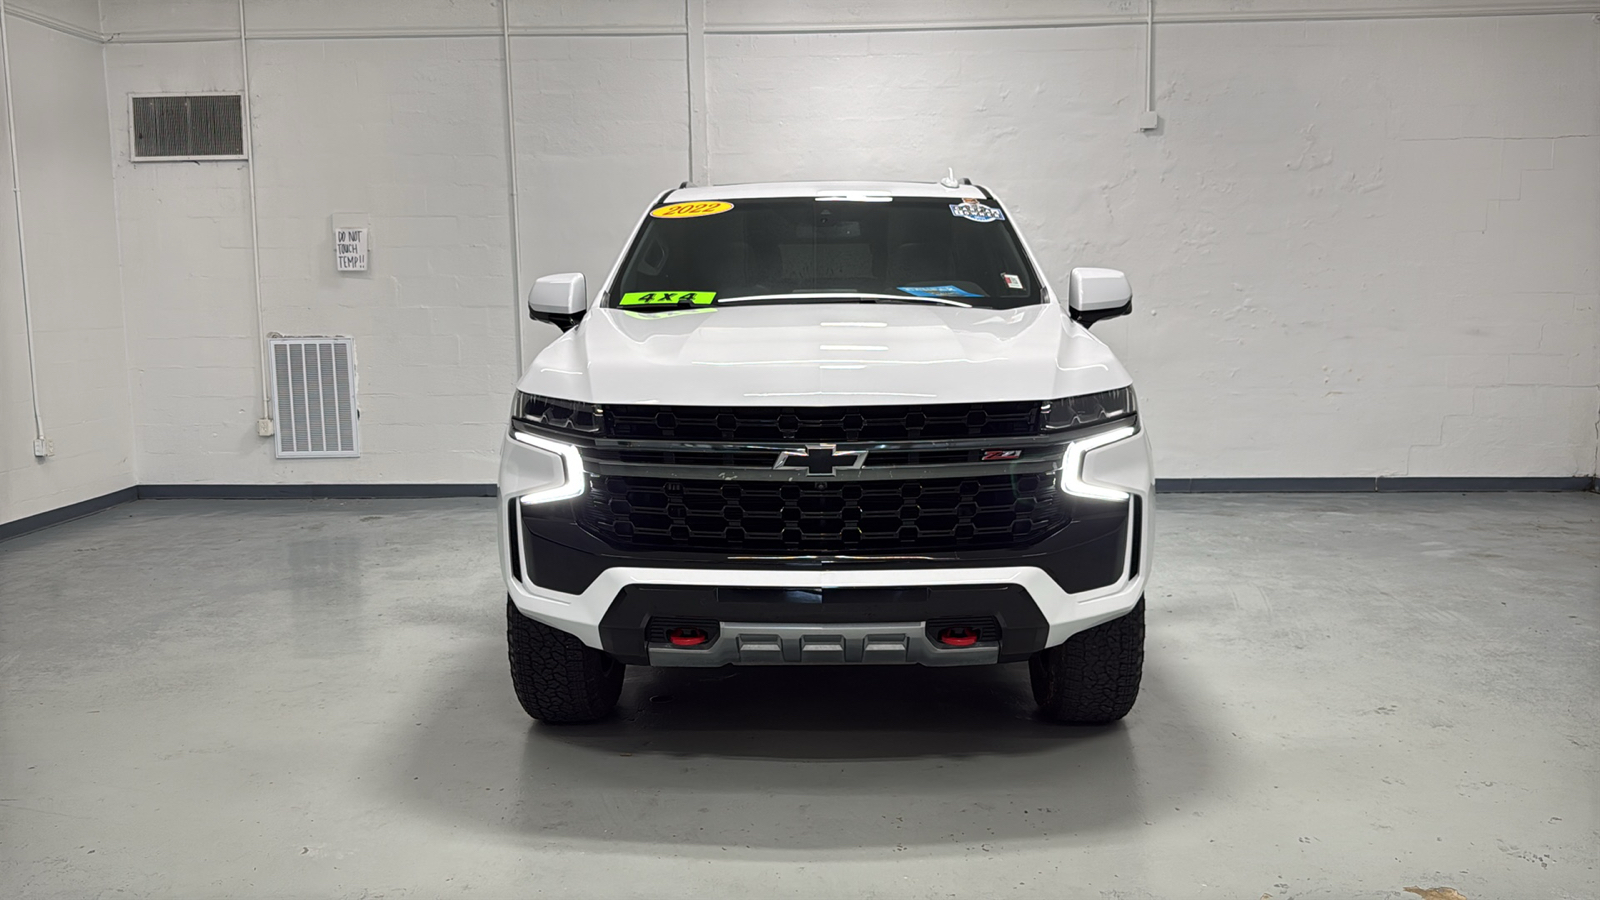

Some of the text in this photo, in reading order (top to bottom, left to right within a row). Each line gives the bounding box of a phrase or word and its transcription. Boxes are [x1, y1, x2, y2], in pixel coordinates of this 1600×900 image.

[662, 203, 721, 216] 2022
[338, 231, 362, 243] DO NOT
[338, 243, 358, 254] TOUCH
[338, 255, 364, 268] TEMP!!
